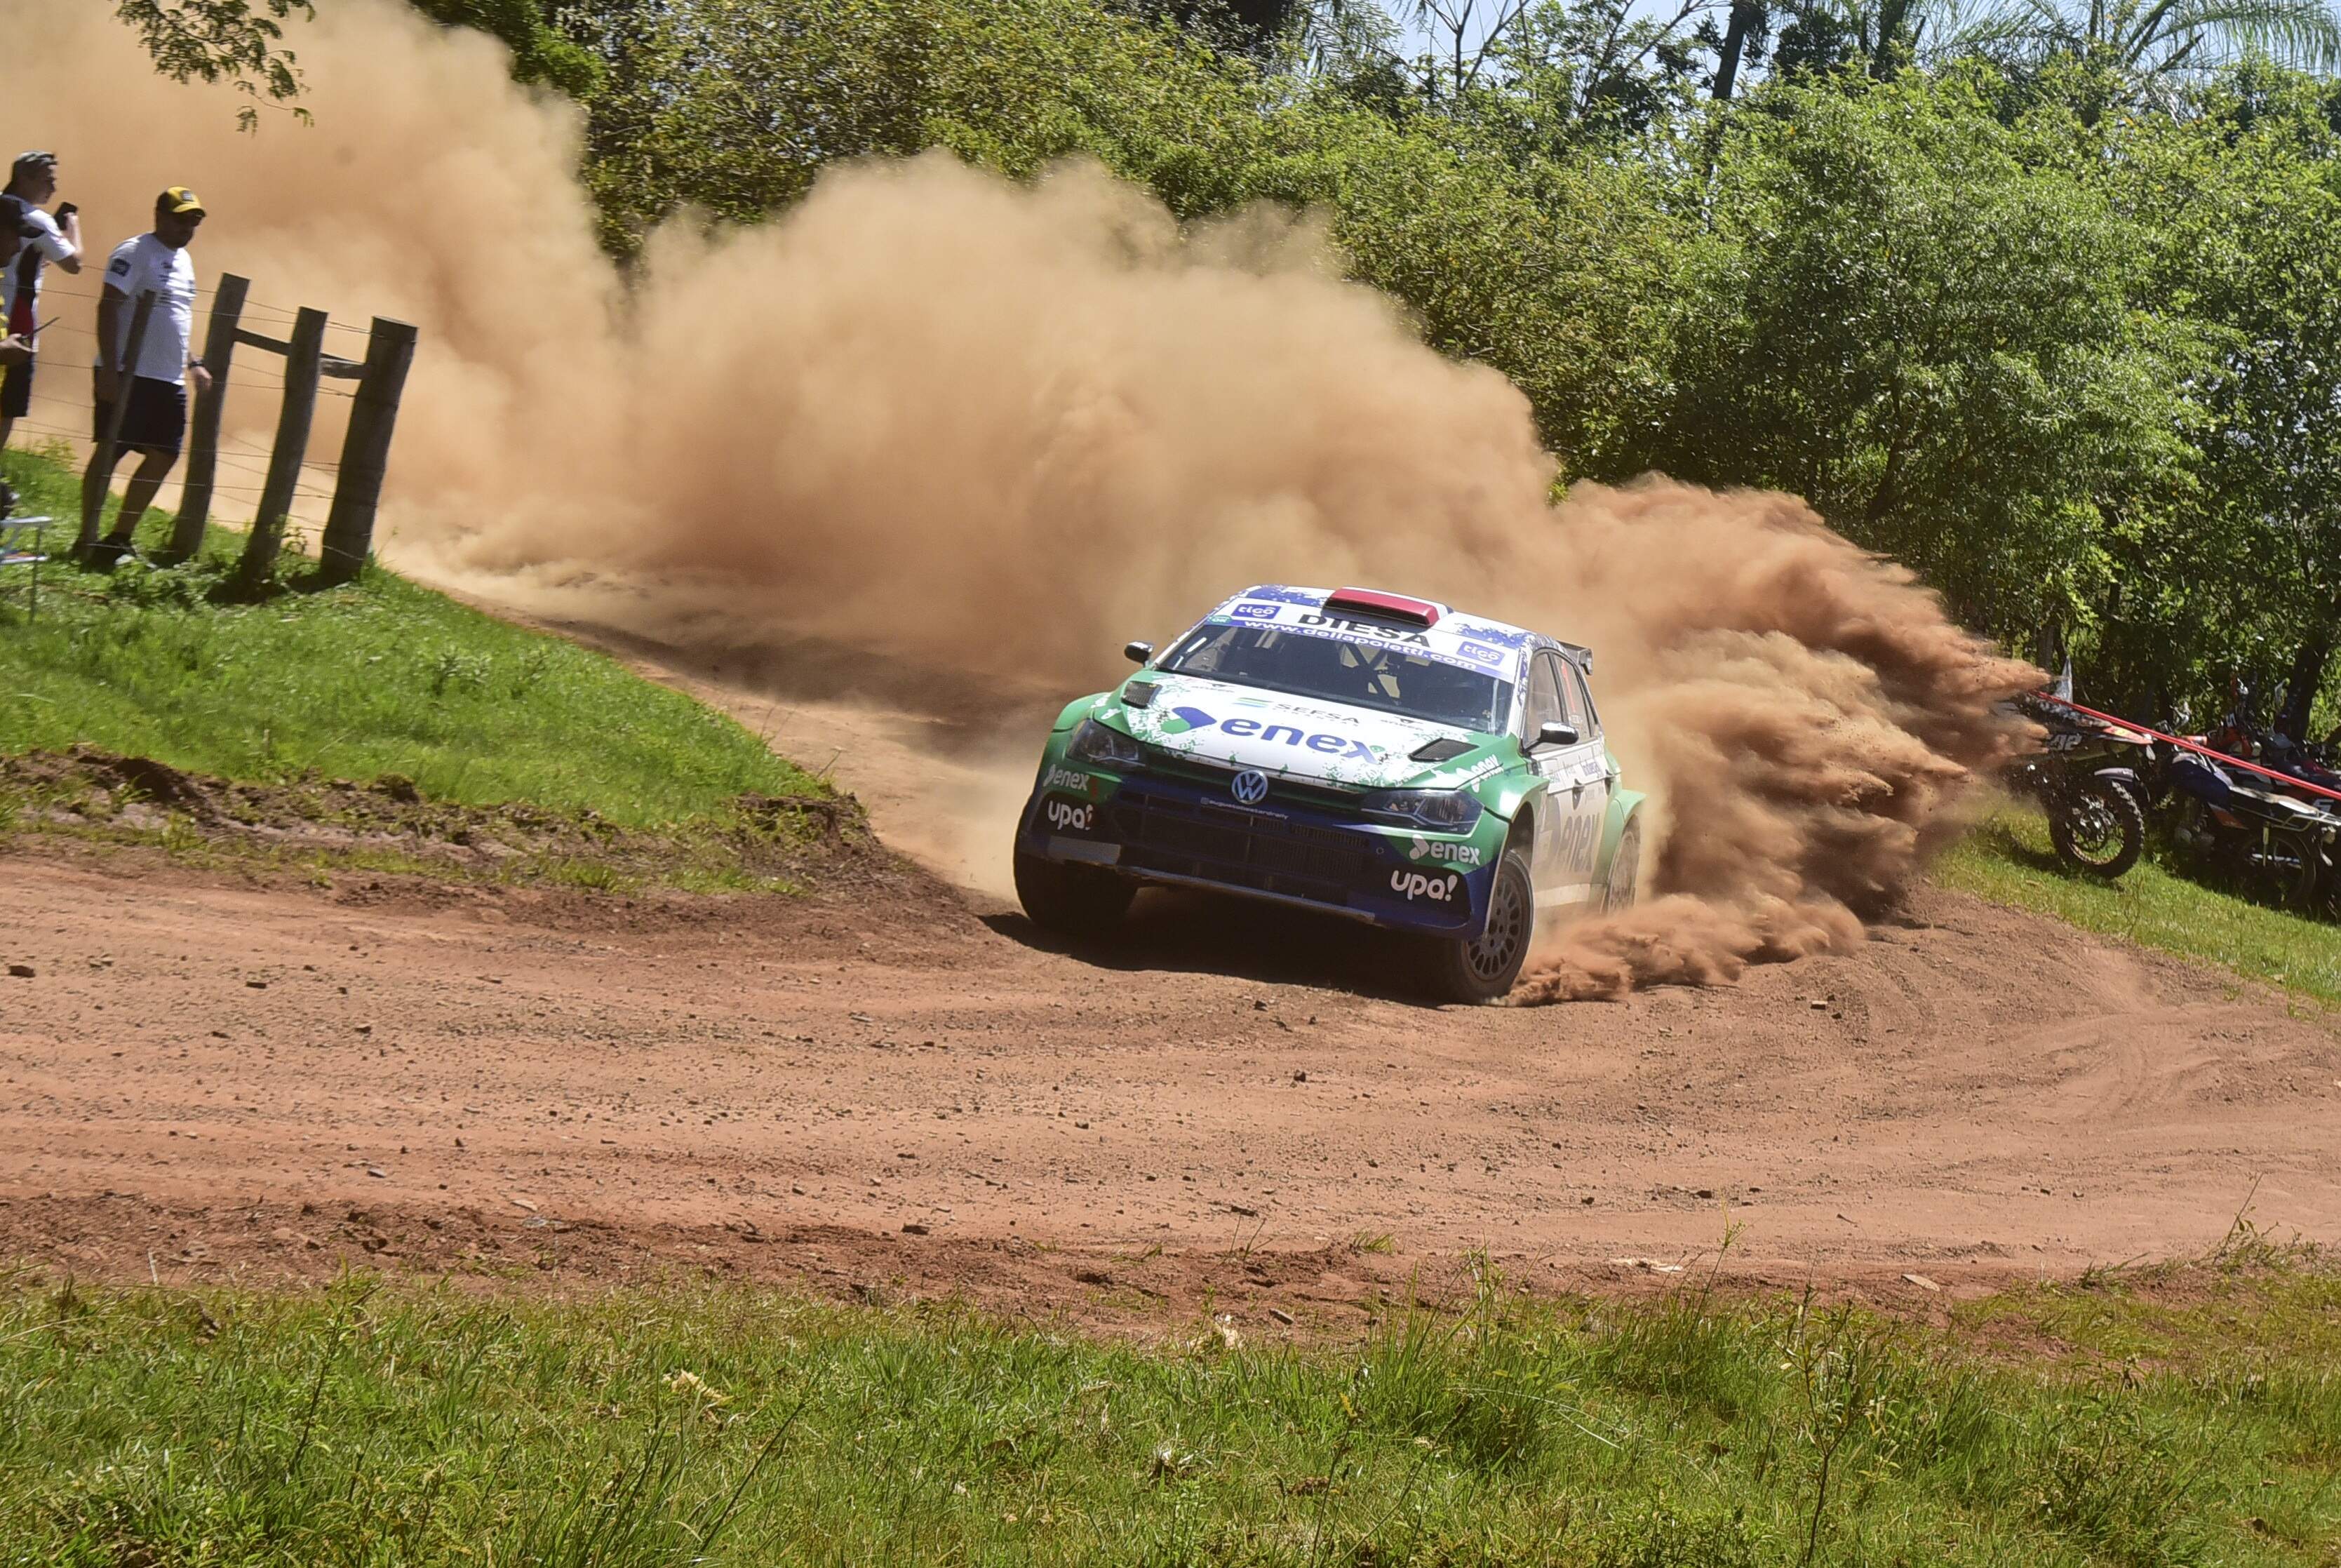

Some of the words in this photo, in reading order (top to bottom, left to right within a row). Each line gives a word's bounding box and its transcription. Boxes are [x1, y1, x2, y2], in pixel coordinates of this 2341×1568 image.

[1298, 614, 1430, 648] DIESA
[1463, 645, 1500, 662] tigo
[1274, 704, 1360, 724] SEFSA
[1221, 718, 1380, 765] enex
[1053, 769, 1089, 791] enex
[1430, 842, 1480, 865] enex
[1391, 870, 1458, 902] upa!
